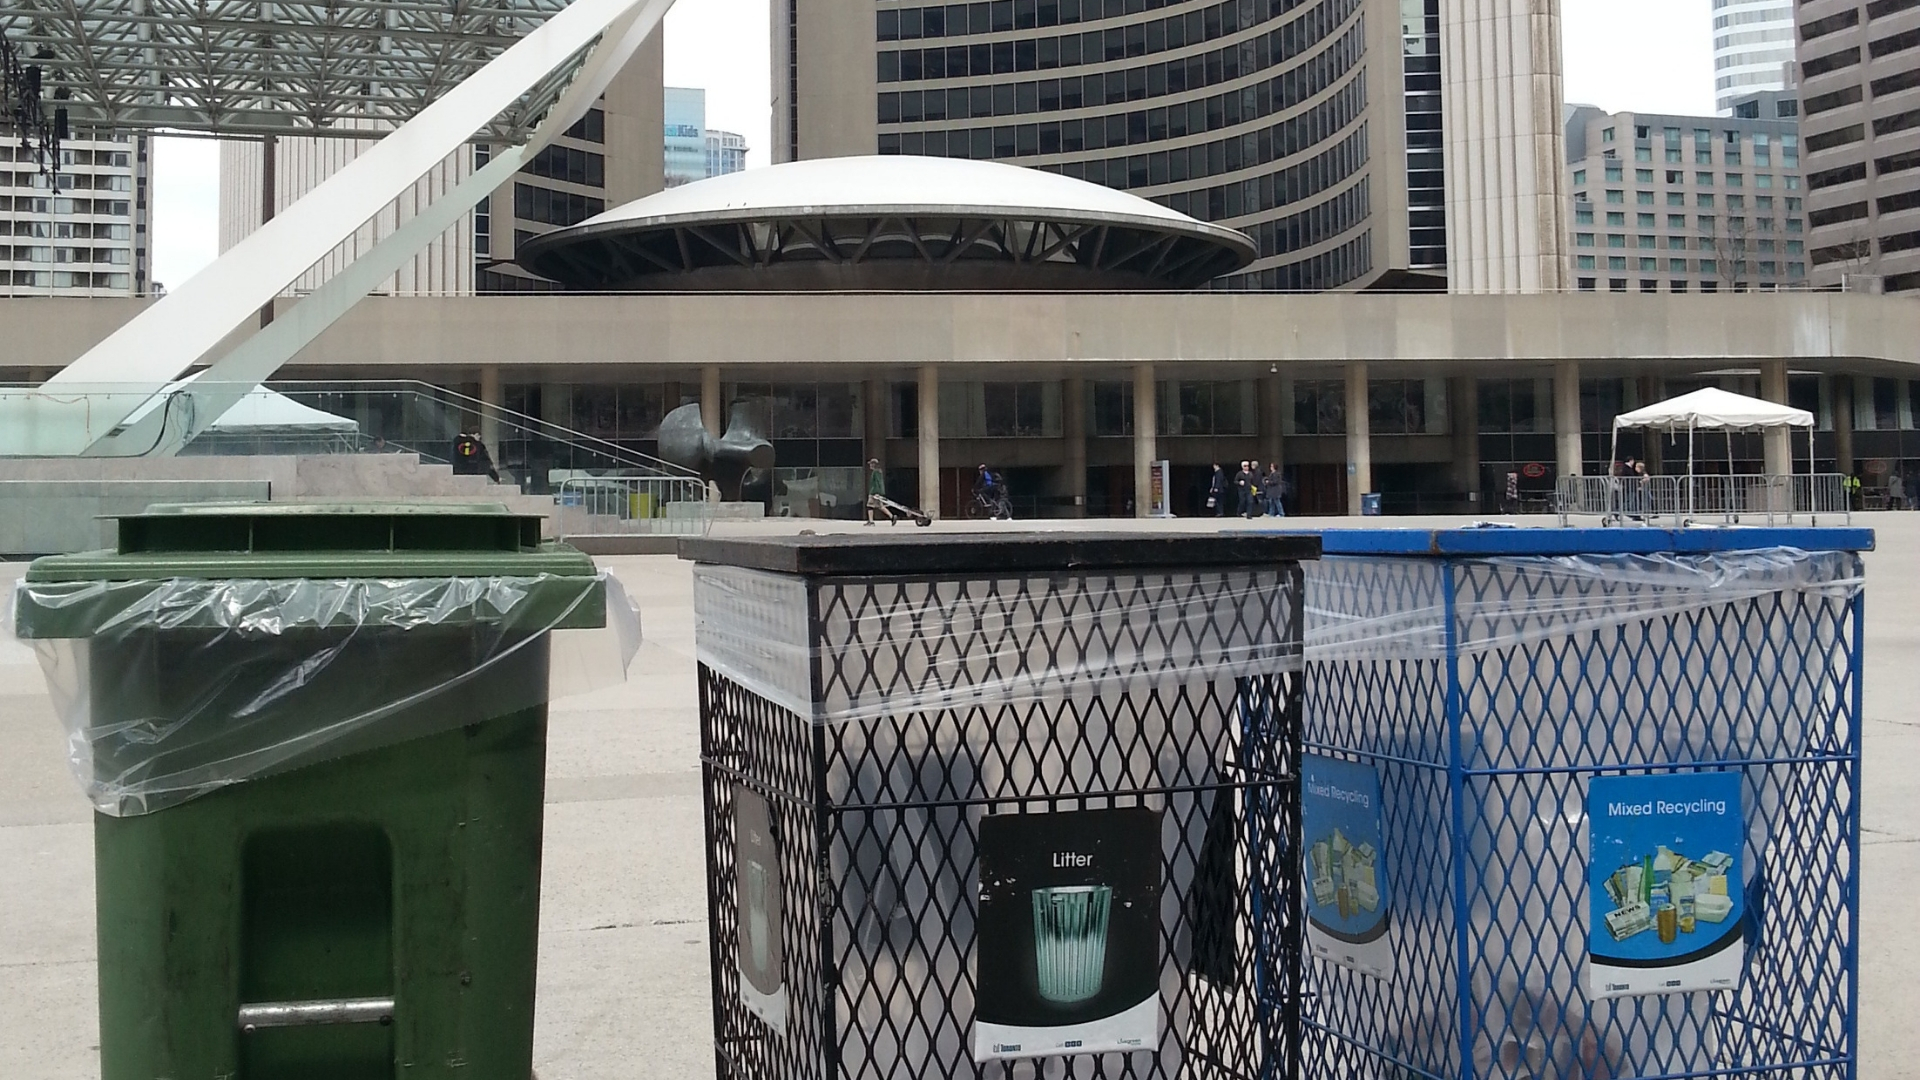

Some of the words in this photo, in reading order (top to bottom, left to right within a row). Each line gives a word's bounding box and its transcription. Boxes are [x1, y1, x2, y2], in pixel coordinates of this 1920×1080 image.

[1330, 785, 1369, 808] Recycling
[1608, 801, 1652, 817] Mixed
[1656, 798, 1726, 816] Recycling
[1053, 851, 1094, 868] Litter
[1613, 904, 1641, 918] NEWS
